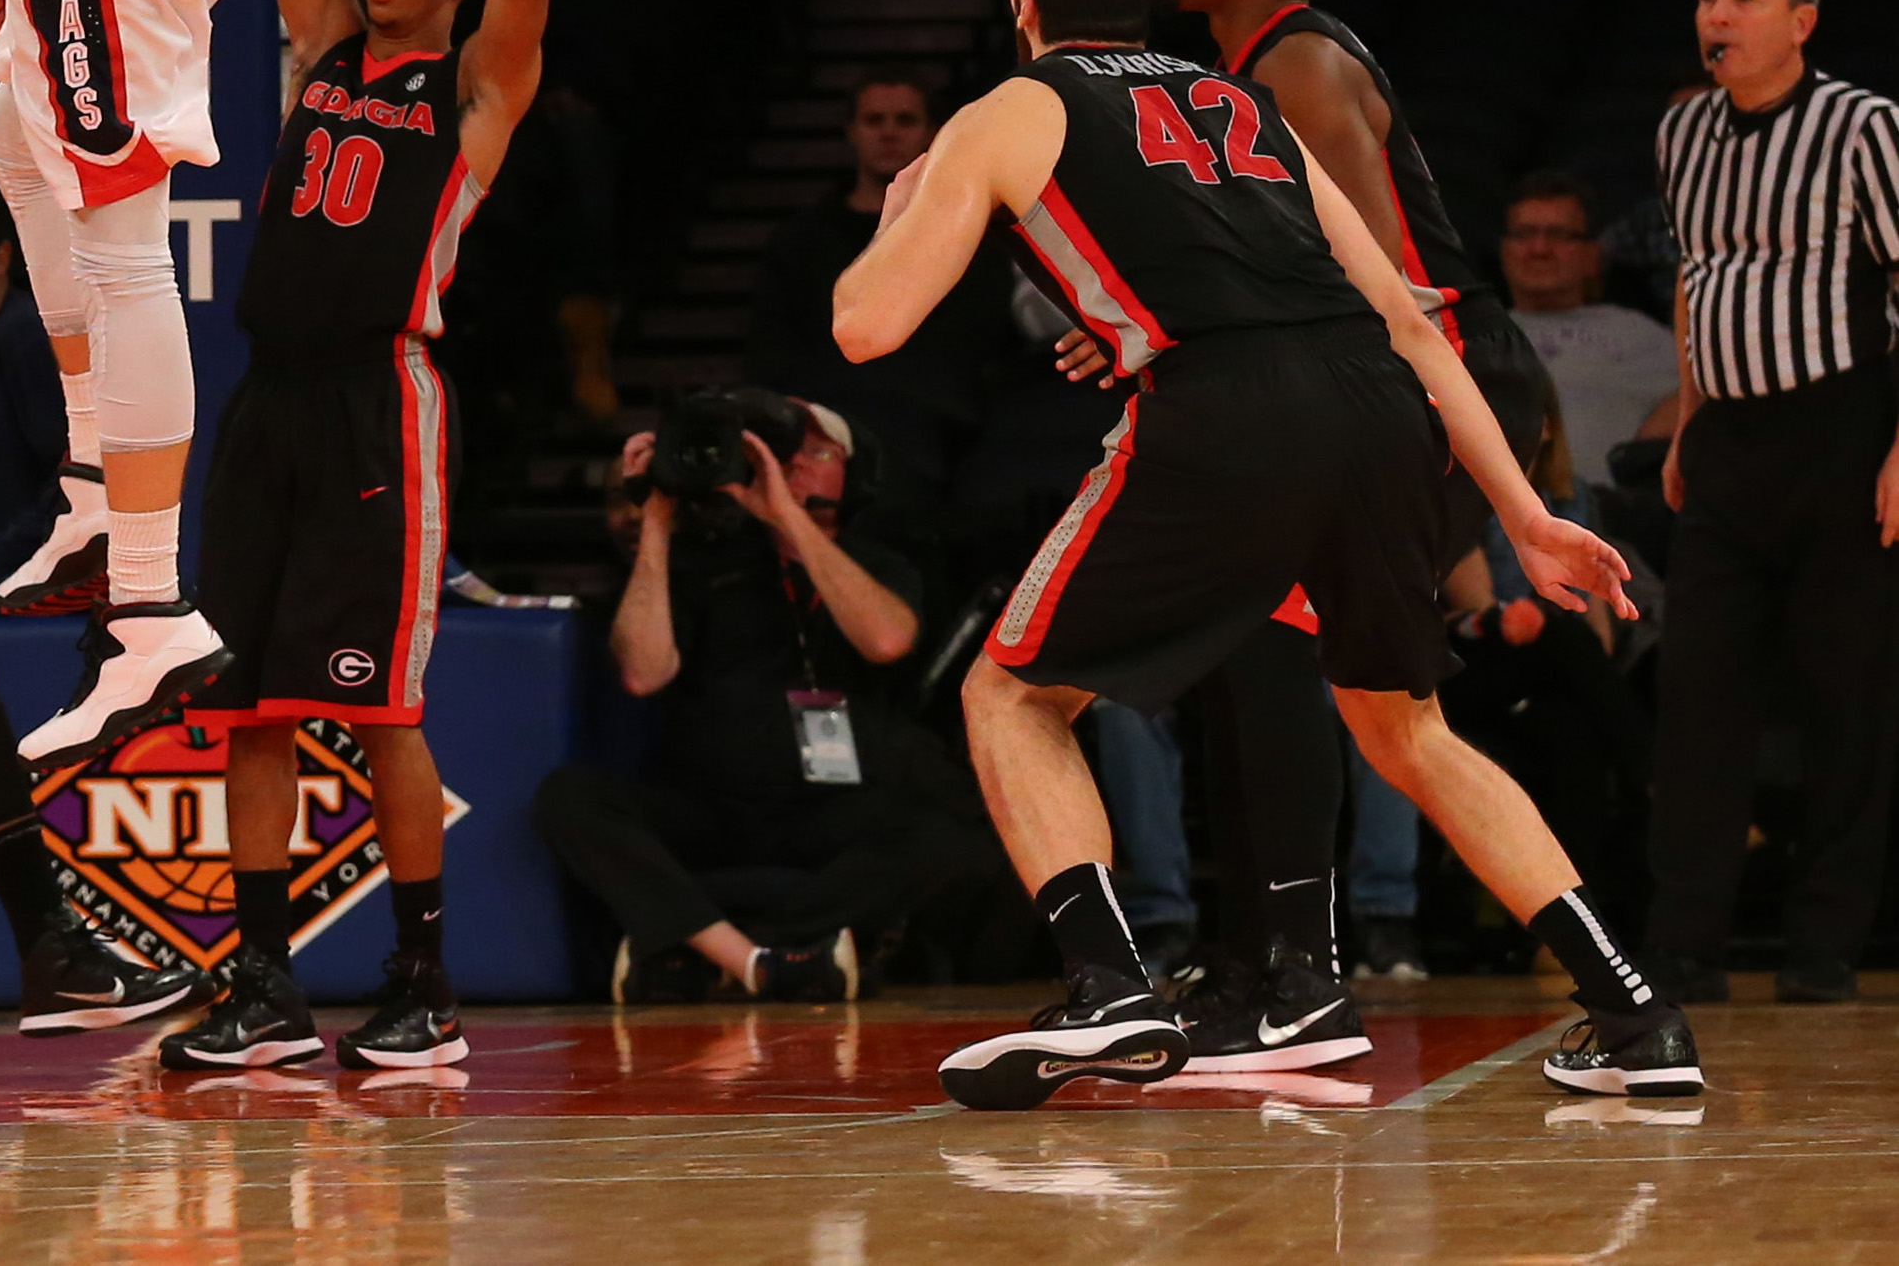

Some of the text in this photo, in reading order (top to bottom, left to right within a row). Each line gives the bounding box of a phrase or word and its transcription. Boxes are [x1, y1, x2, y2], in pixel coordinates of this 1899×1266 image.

[291, 126, 386, 228] 30
[1129, 77, 1297, 186] 42
[332, 651, 375, 683] G
